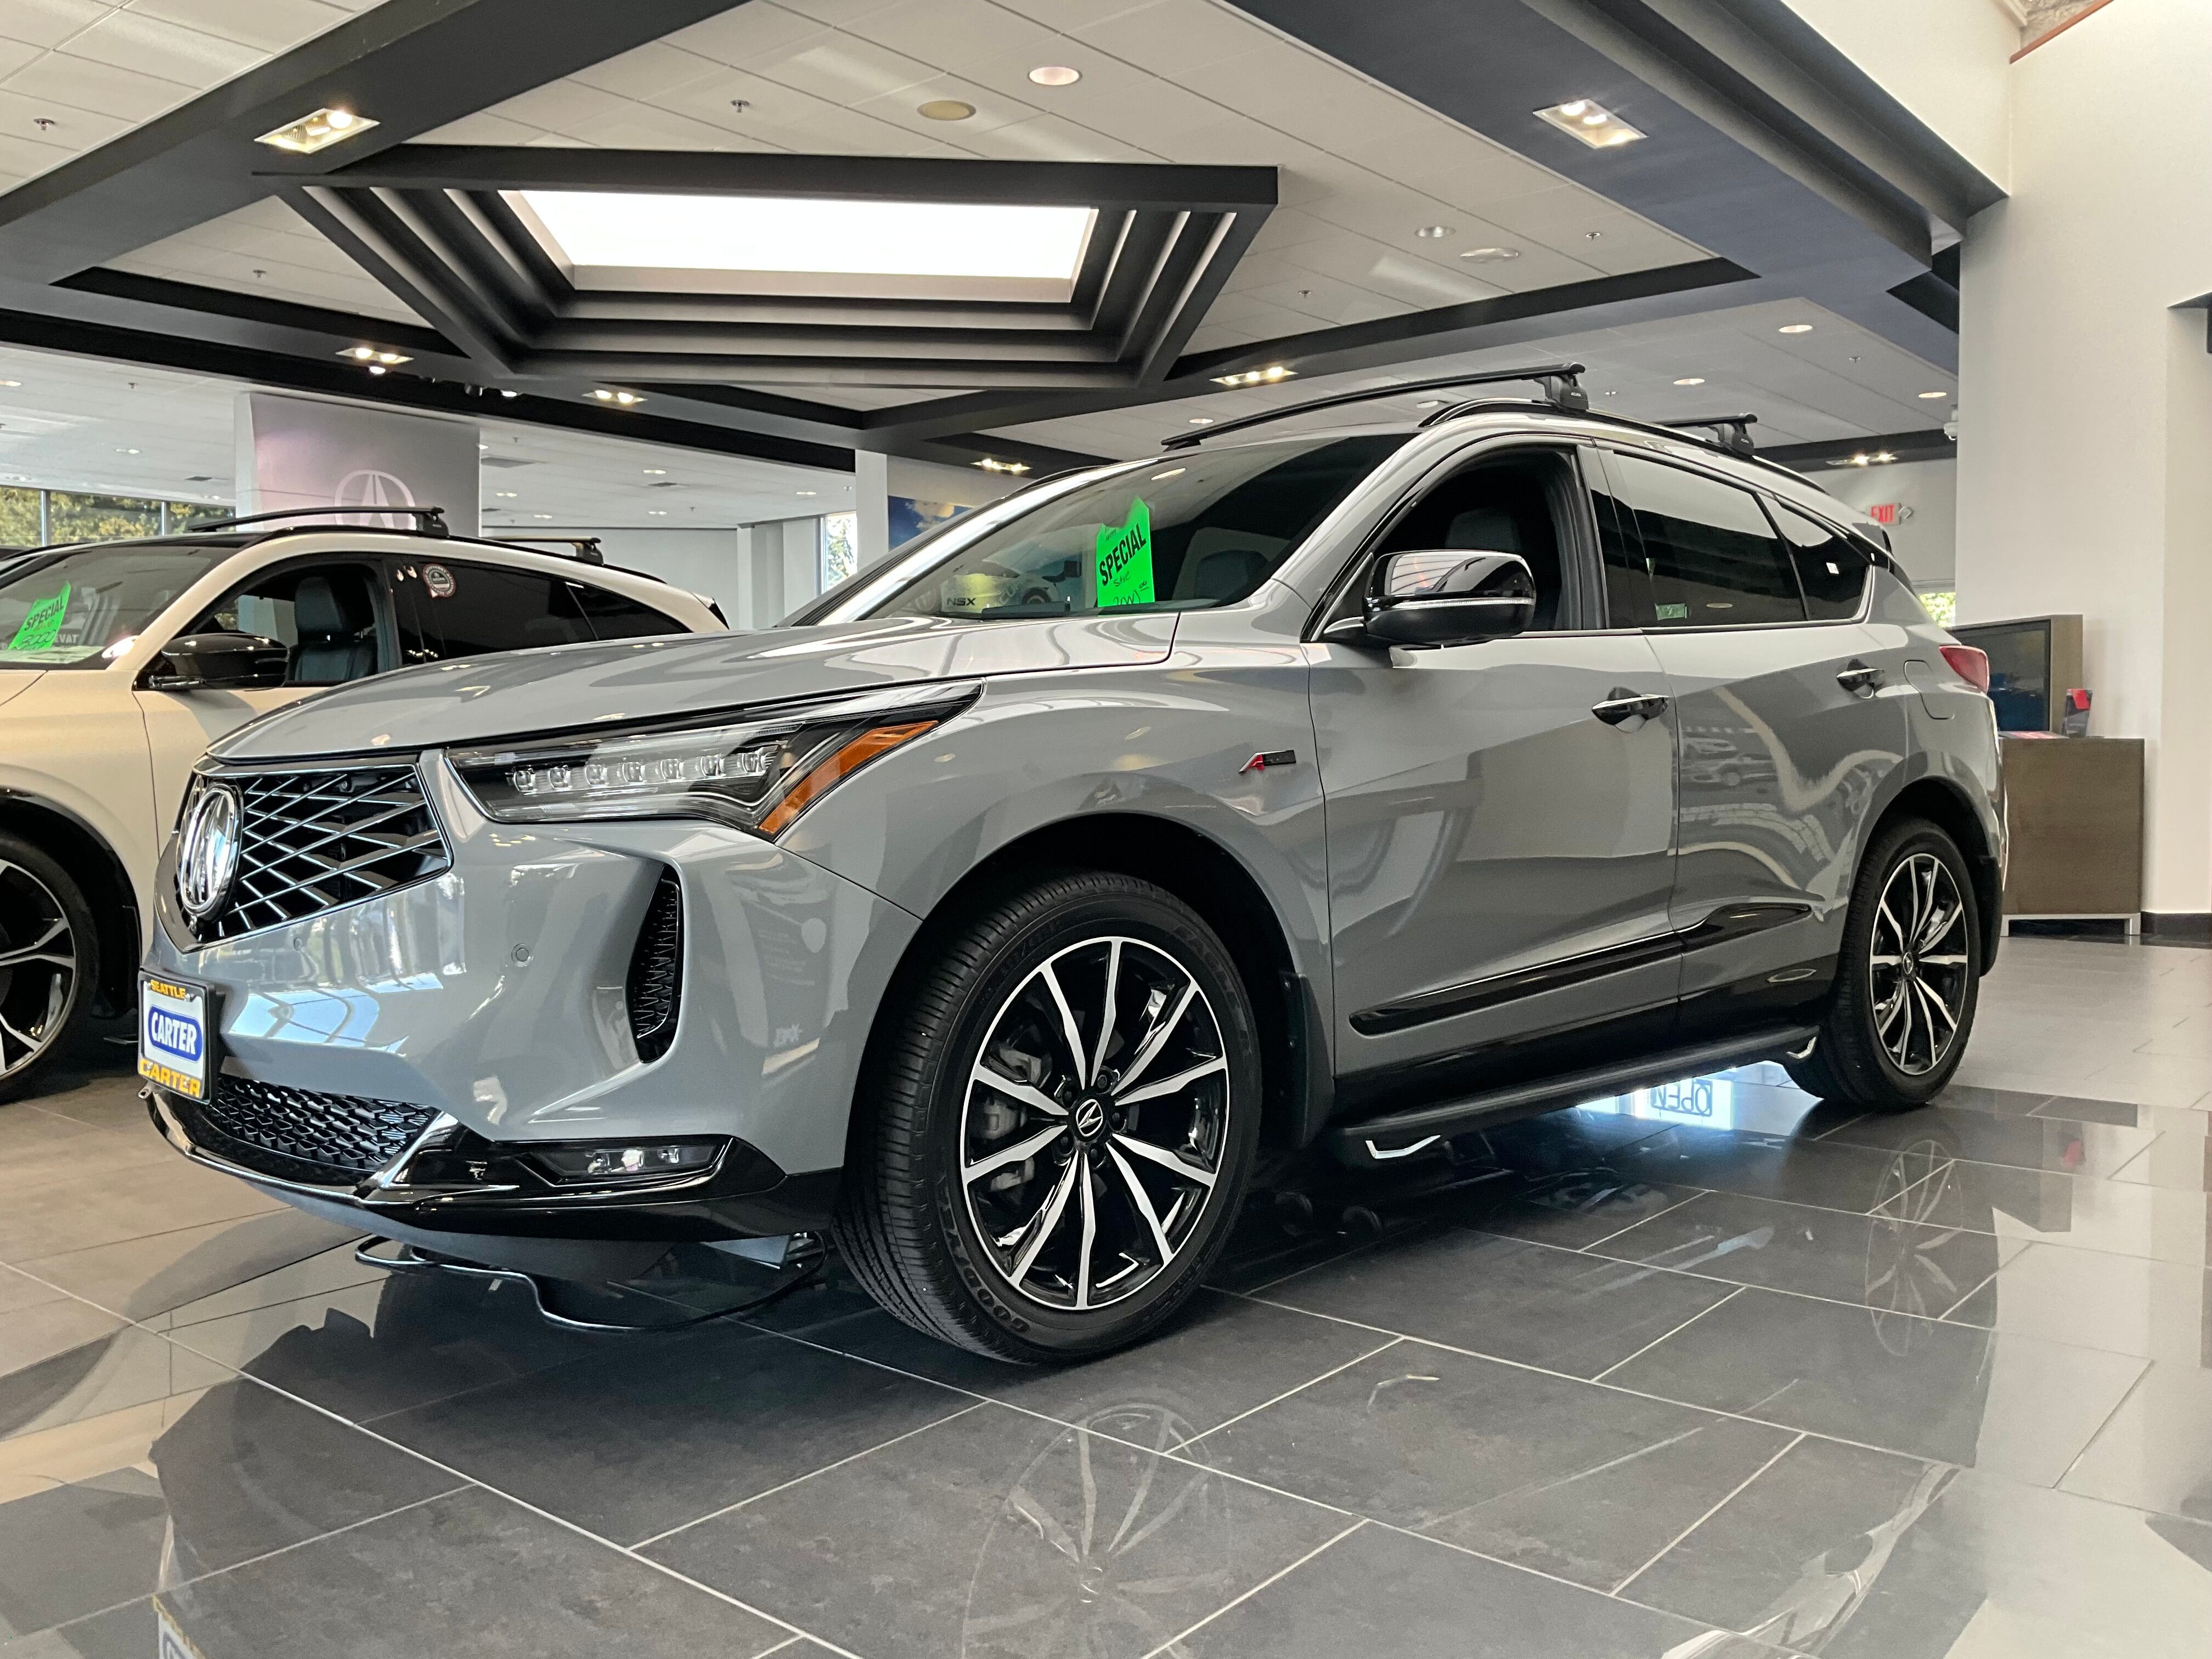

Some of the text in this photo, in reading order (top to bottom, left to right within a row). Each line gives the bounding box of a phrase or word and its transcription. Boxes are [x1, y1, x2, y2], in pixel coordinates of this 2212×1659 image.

[1871, 504, 1894, 523] EXIT
[1099, 523, 1147, 586] SPECIAL
[24, 595, 64, 631] SPECIAL
[946, 597, 976, 606] NSX
[150, 979, 186, 999] SEATTLE
[151, 1012, 197, 1054] CARTER
[139, 1058, 201, 1098] CARTER
[1654, 1079, 1711, 1113] OPEN
[934, 1155, 1030, 1333] GOODYEA
